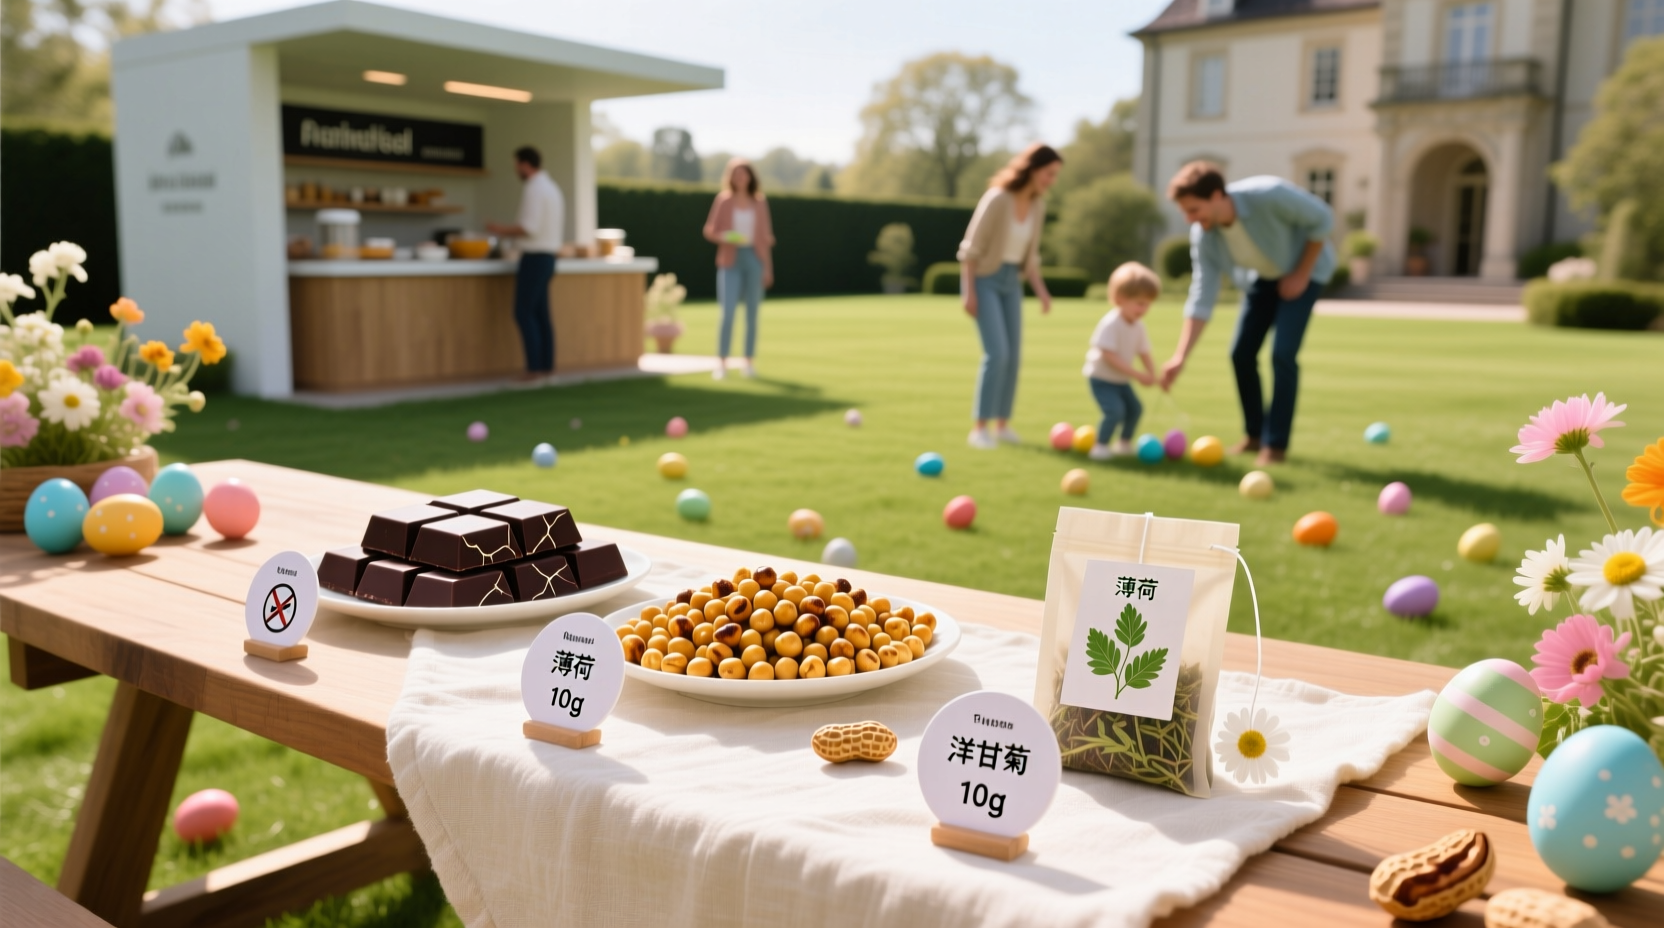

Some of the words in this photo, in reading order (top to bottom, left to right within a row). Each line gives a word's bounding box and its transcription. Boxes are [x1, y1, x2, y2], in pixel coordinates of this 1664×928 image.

[1115, 576, 1159, 601] 薄荷
[551, 649, 596, 681] 薄荷
[551, 687, 585, 718] 10g
[947, 735, 1031, 776] 洋甘菊
[961, 781, 1006, 819] 10g
